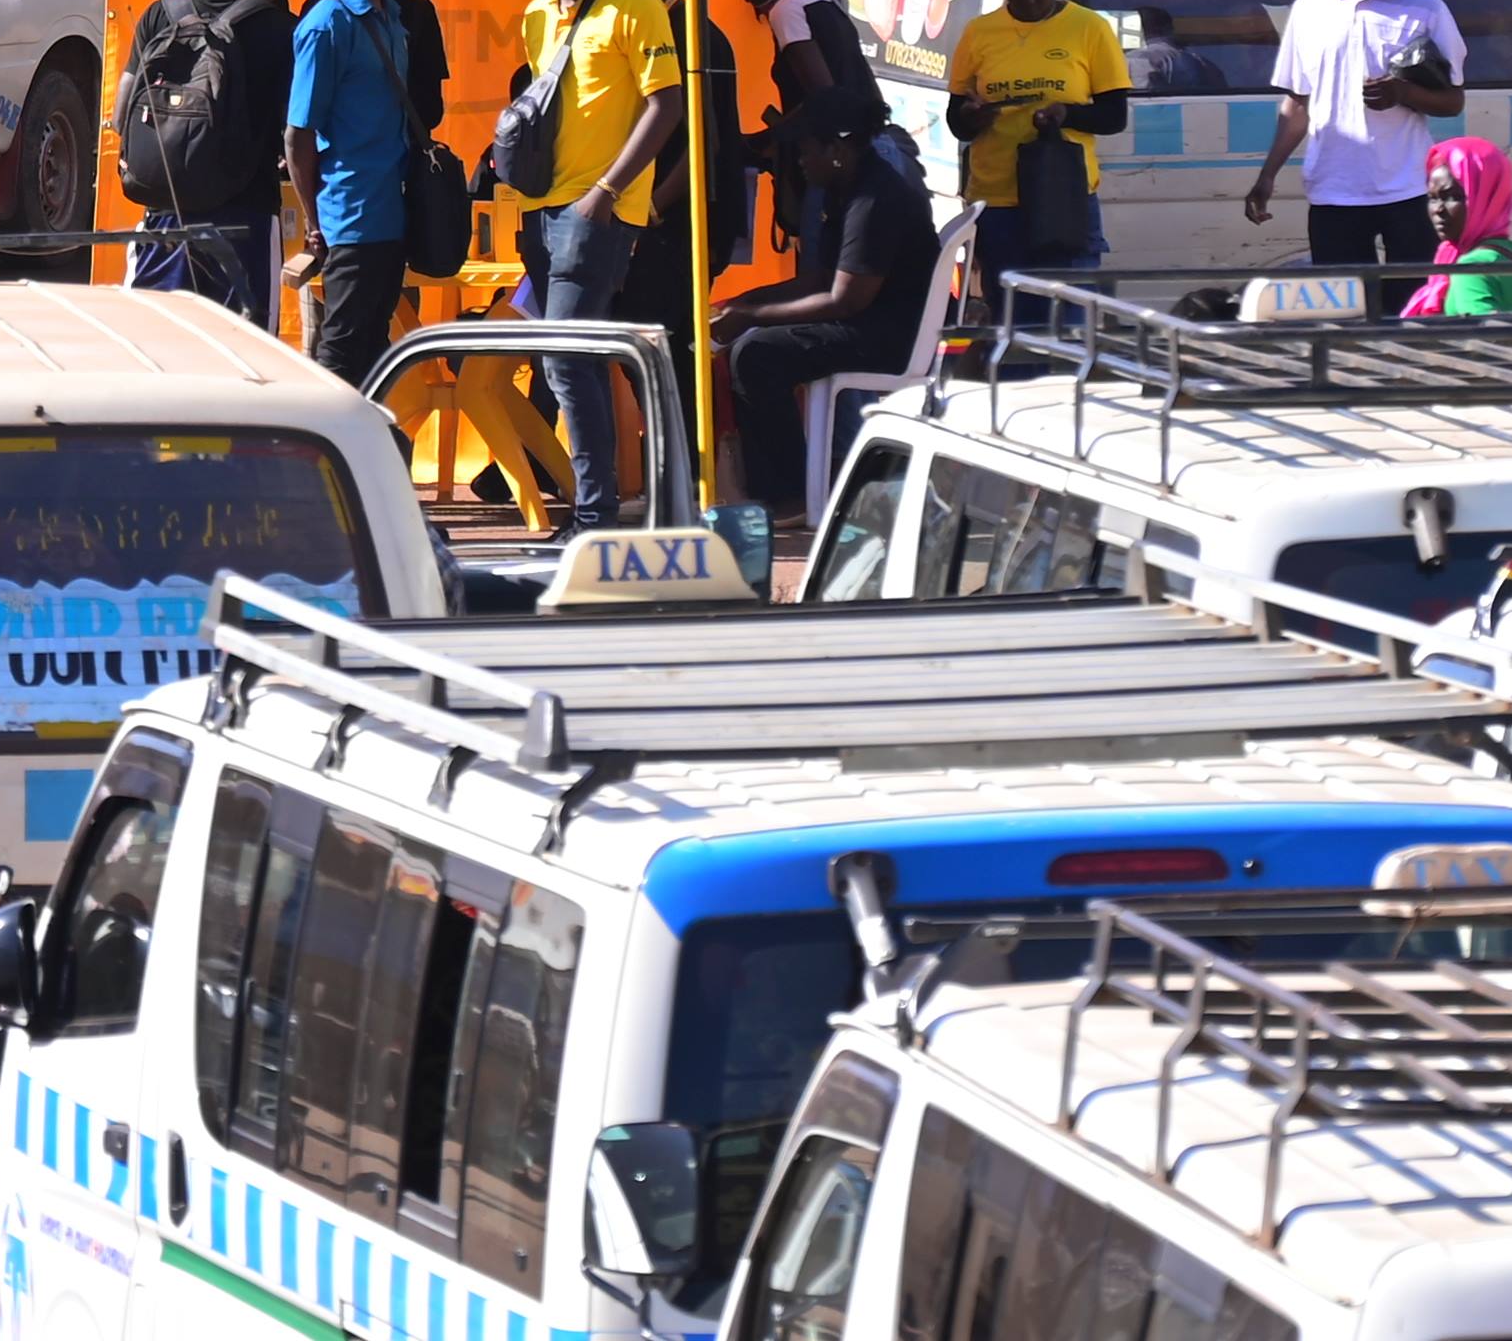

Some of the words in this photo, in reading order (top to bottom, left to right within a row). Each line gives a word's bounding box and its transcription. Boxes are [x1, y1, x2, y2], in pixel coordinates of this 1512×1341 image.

[986, 81, 1011, 94] SIM
[1014, 77, 1066, 92] Selling
[1269, 281, 1358, 310] TAXI
[590, 538, 712, 582] TAXI
